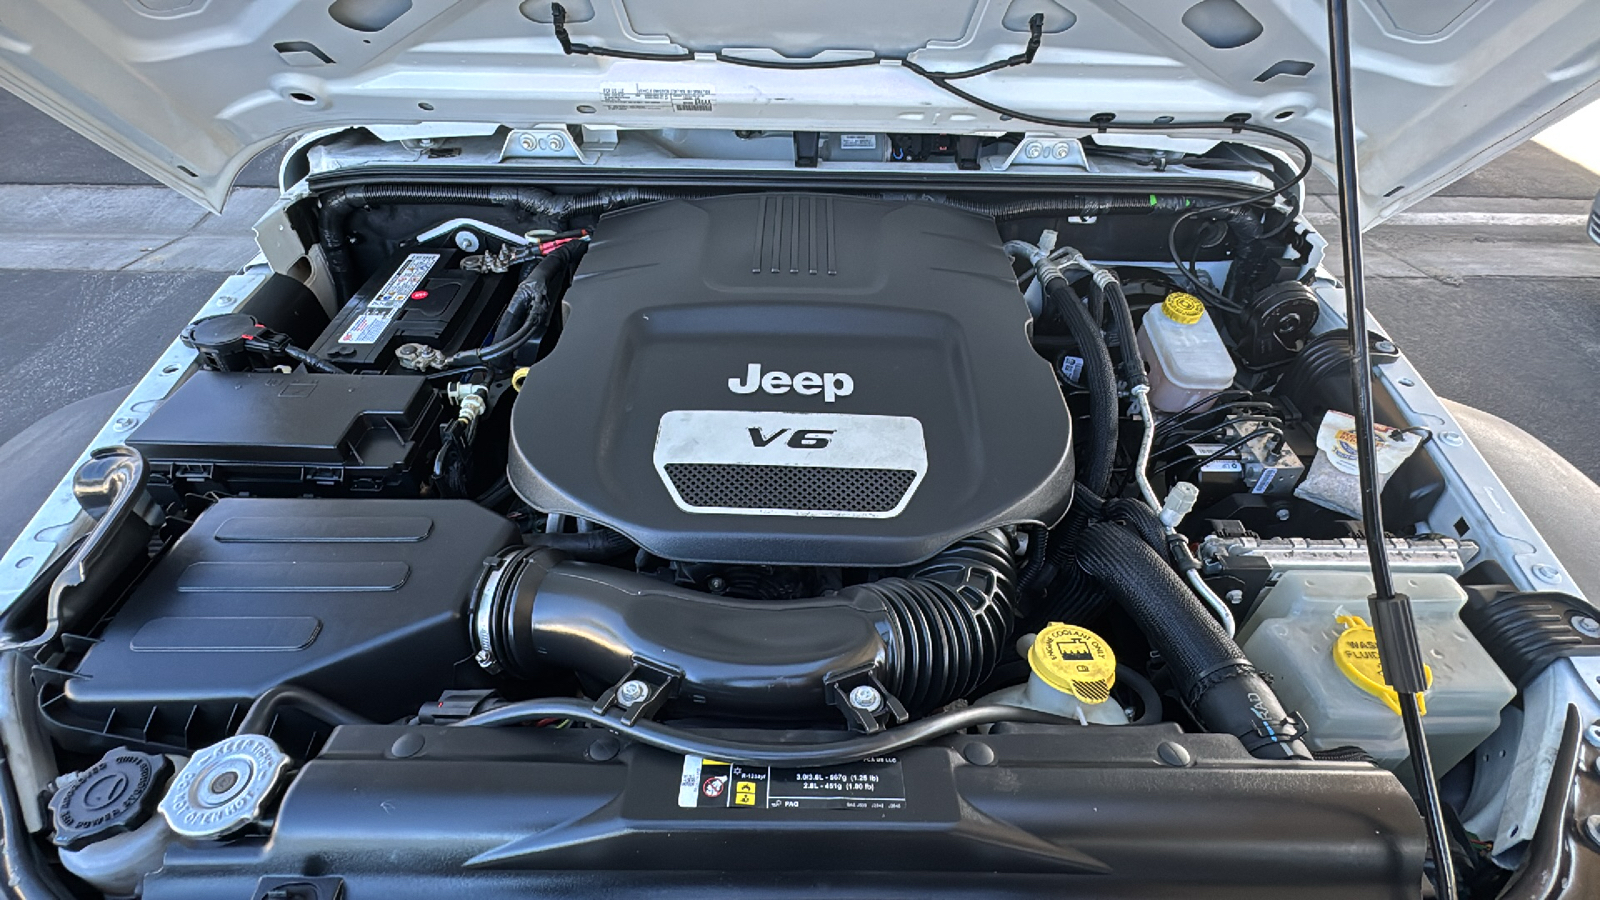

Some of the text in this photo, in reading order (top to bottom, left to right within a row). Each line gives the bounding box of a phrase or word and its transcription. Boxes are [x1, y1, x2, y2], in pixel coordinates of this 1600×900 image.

[727, 363, 854, 403] Jeep
[747, 427, 837, 449] V6
[1051, 629, 1091, 641] COOLANT
[1091, 641, 1106, 660] ONLY
[864, 783, 874, 791] lb)
